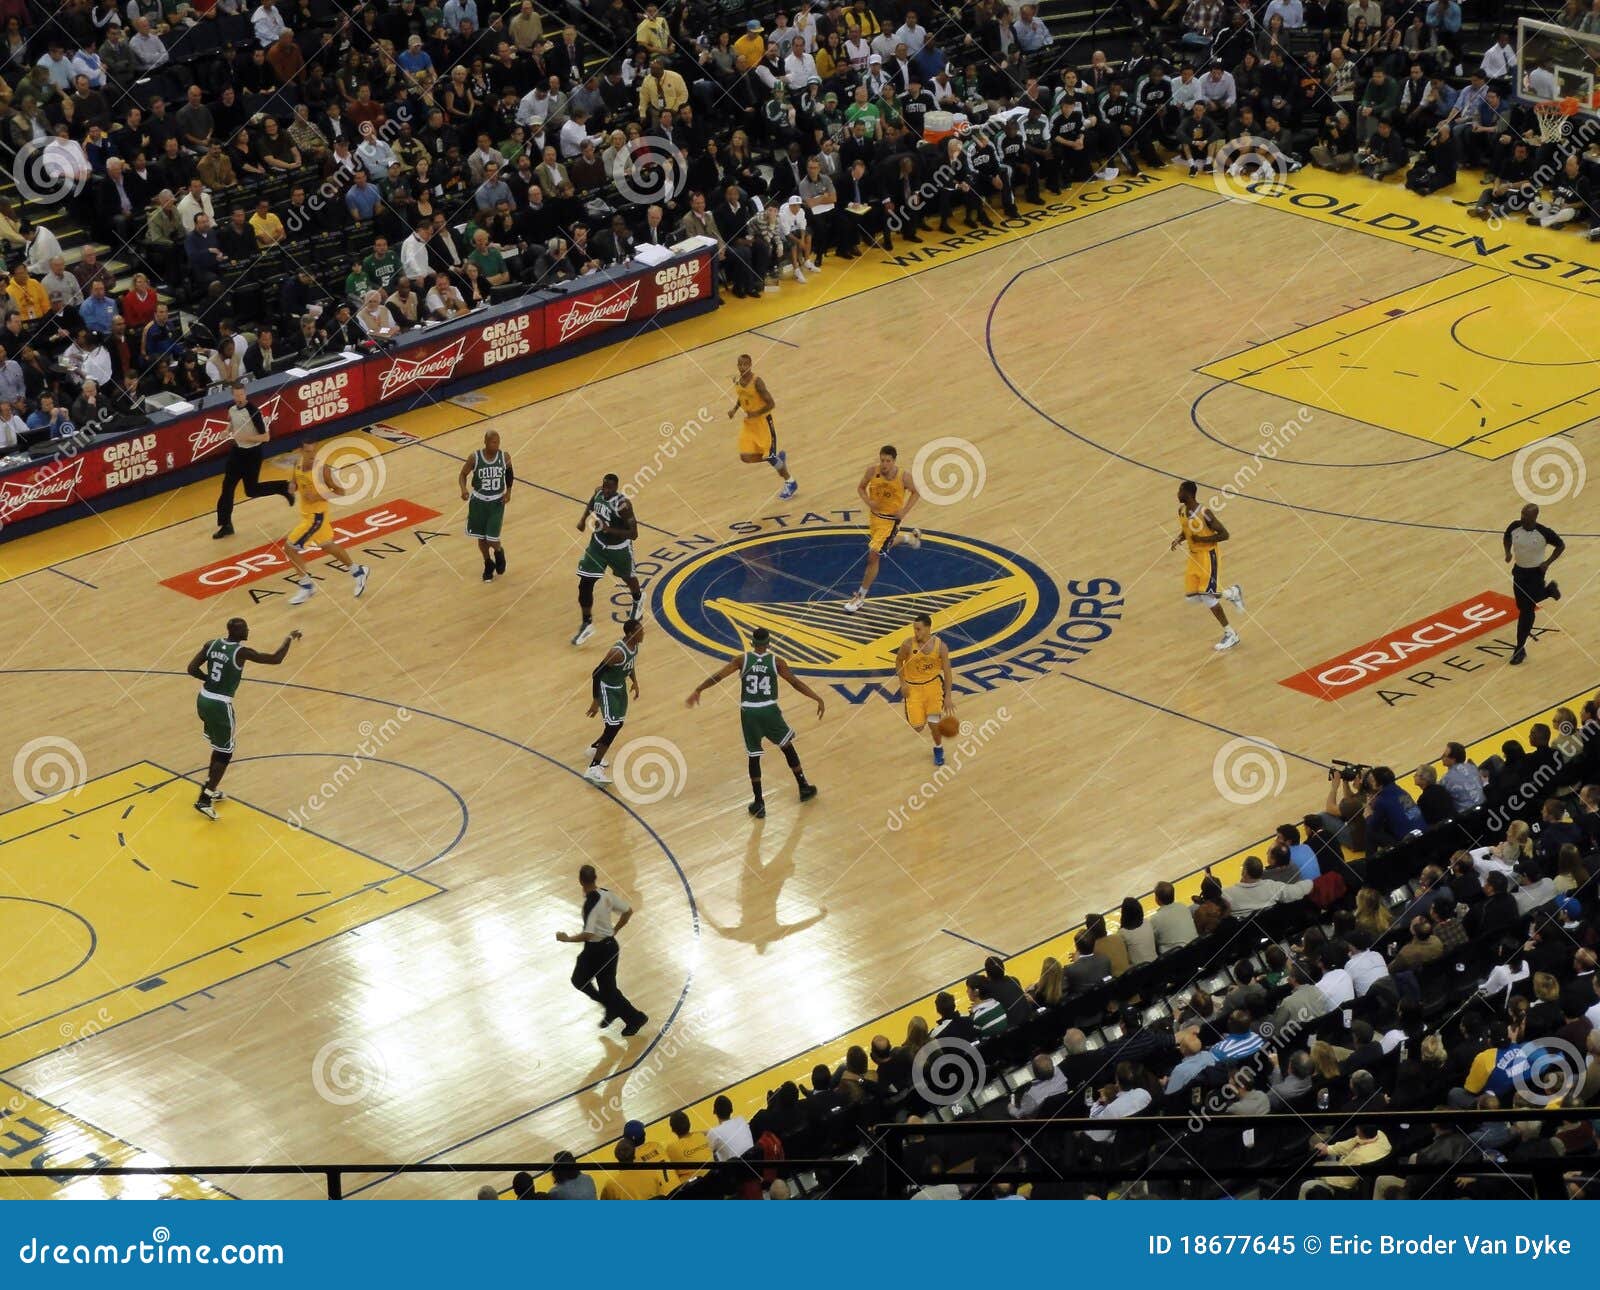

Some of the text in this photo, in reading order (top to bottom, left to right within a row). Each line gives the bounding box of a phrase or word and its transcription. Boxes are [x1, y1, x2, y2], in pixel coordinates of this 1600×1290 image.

[882, 174, 1163, 268] WARRIORS.COM
[1246, 181, 1511, 257] GOLDEN
[655, 259, 699, 286] GRAB
[663, 275, 693, 292] SOME
[656, 283, 699, 310] BUDS
[559, 296, 638, 333] Budweiser
[483, 315, 530, 343] GRAB
[490, 331, 522, 349] SOME
[484, 339, 530, 367] BUDS
[298, 373, 348, 401] GRAB
[379, 353, 464, 393] Budweiser
[300, 398, 349, 426] BUDS
[307, 388, 340, 408] SOME
[103, 434, 157, 463] GRAB
[113, 450, 148, 472] SOME
[105, 461, 158, 489] BUDS
[481, 478, 501, 491] 20
[729, 509, 861, 535] STAT
[199, 510, 408, 587] ORLE
[1318, 603, 1506, 686] ORACLE
[211, 661, 224, 682] 5
[1376, 626, 1560, 707] ARENA
[746, 675, 772, 695] 34
